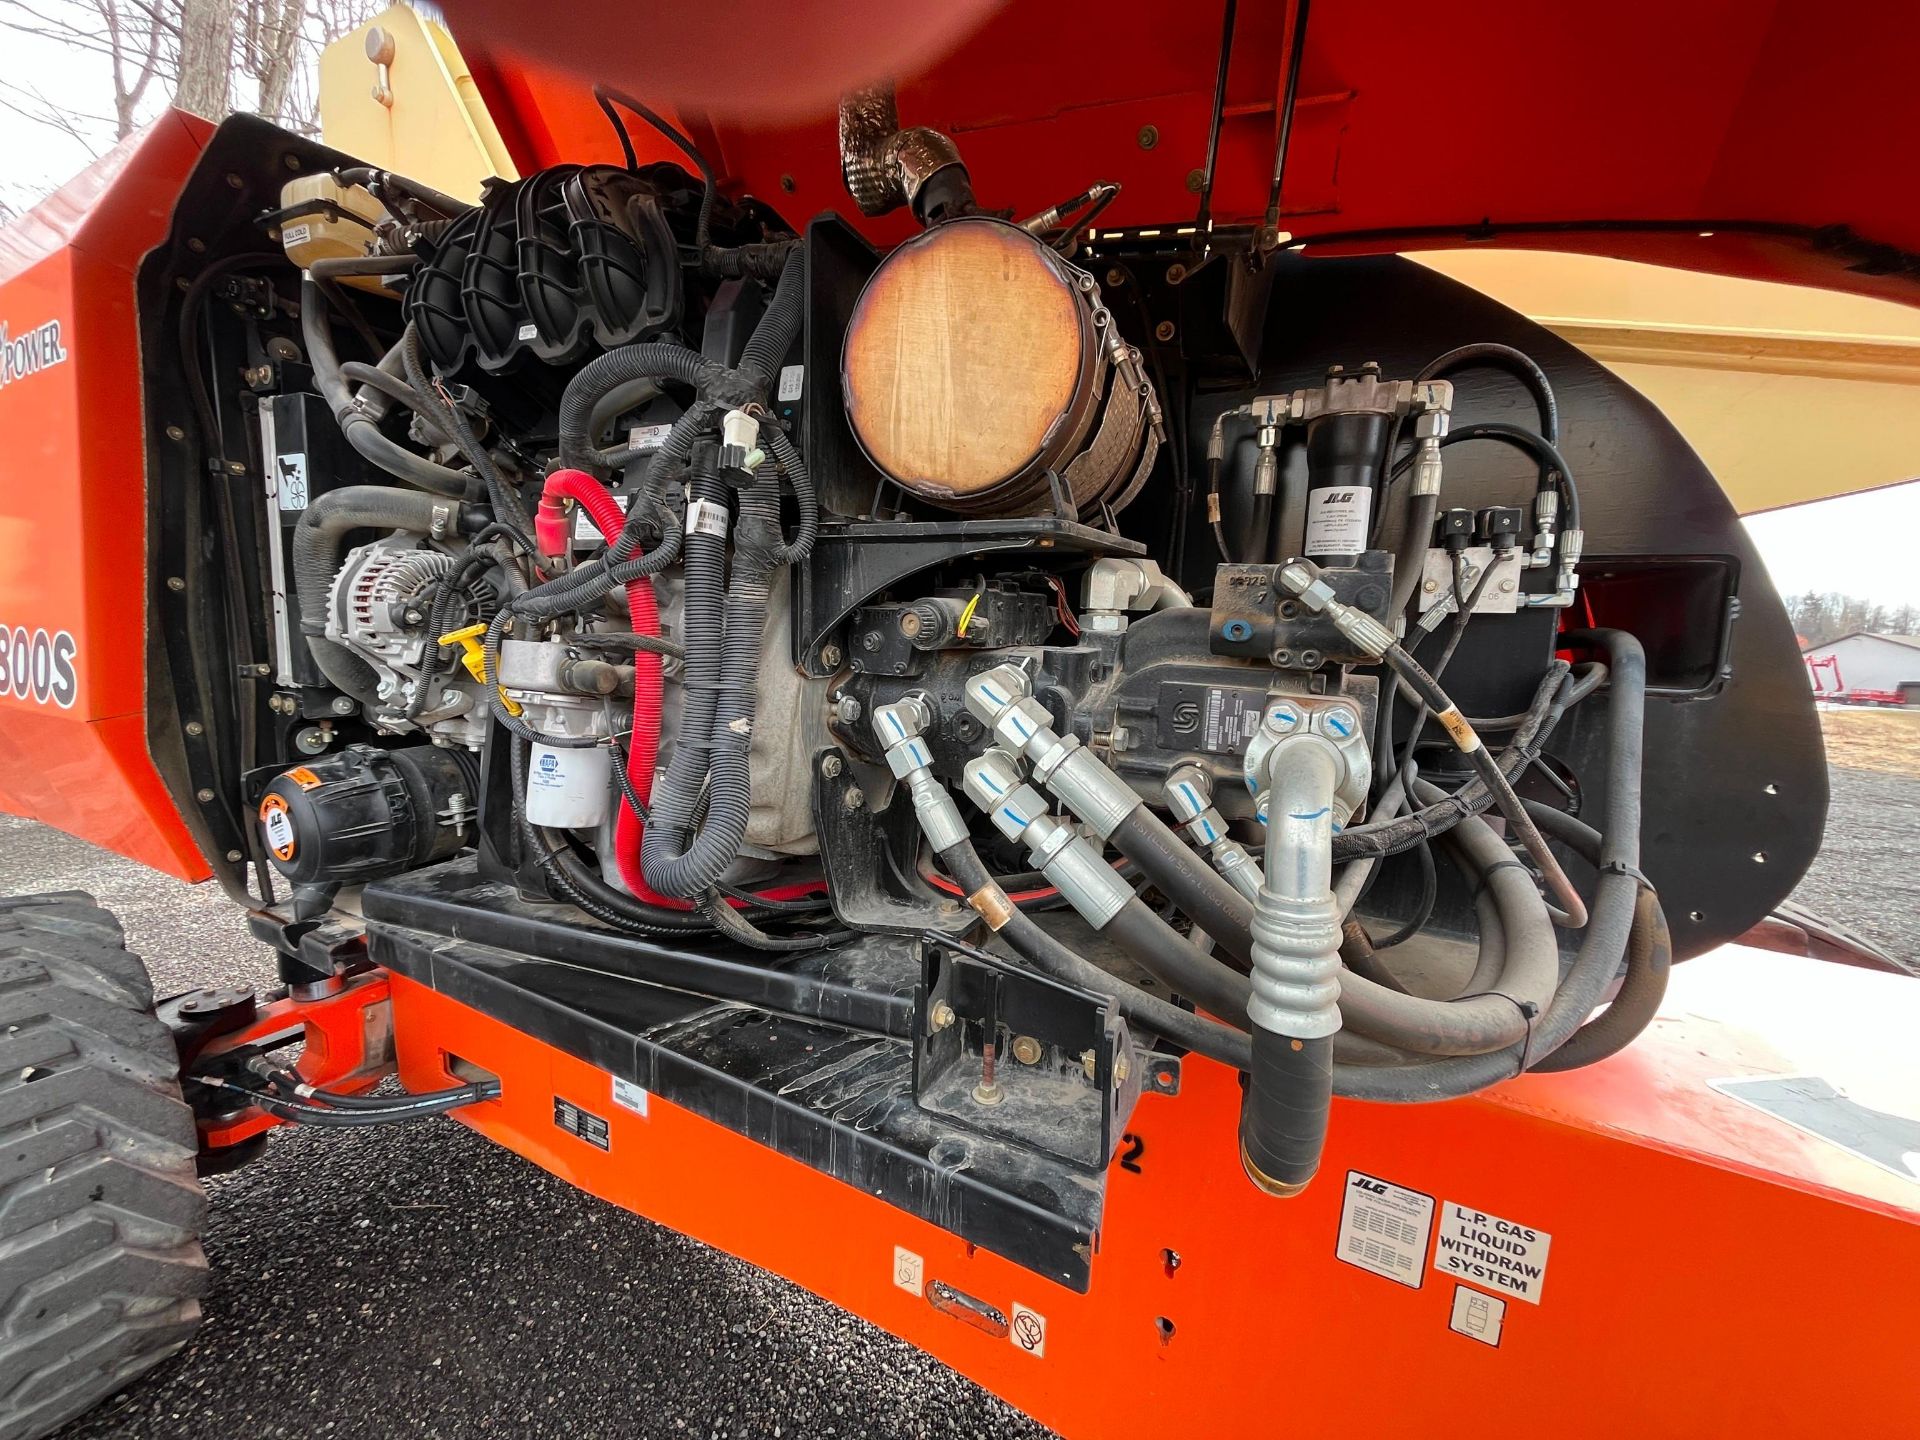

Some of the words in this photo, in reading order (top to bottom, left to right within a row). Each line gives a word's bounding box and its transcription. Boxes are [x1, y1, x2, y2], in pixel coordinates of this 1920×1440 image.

[5, 321, 62, 382] POWER
[1323, 492, 1355, 505] JLG
[270, 812, 283, 828] JLG
[1120, 1133, 1145, 1174] 2
[1351, 1178, 1389, 1196] JLG
[1456, 1207, 1487, 1228] L.P.
[1495, 1220, 1536, 1243] GAS
[1459, 1225, 1527, 1257] LIQUID
[1440, 1235, 1542, 1280] WITHDRAW
[1447, 1256, 1528, 1293] SYSTEM
